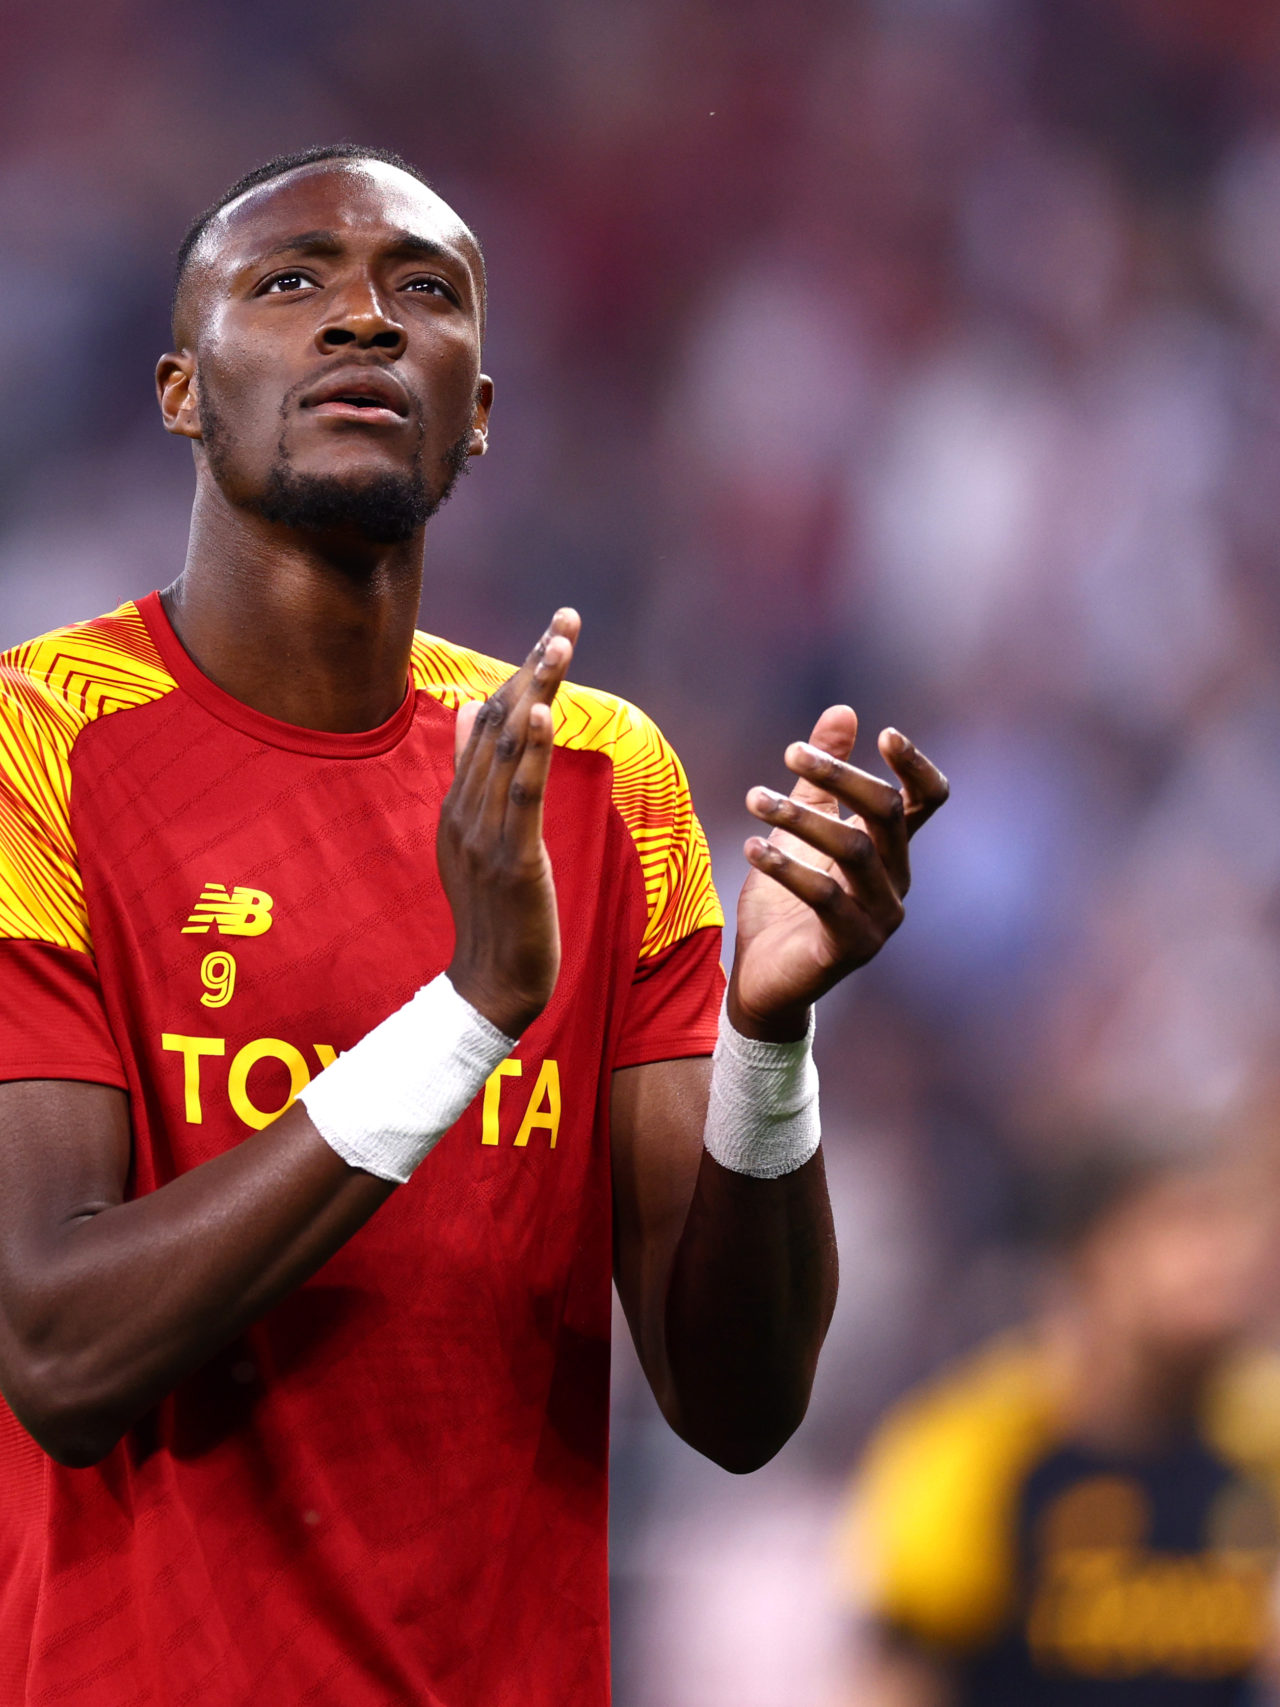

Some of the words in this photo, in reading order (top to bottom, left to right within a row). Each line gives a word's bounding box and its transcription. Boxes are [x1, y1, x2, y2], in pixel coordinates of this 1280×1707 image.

[181, 882, 273, 937] NB
[200, 951, 236, 1008] 9
[161, 1033, 562, 1149] TOTA
